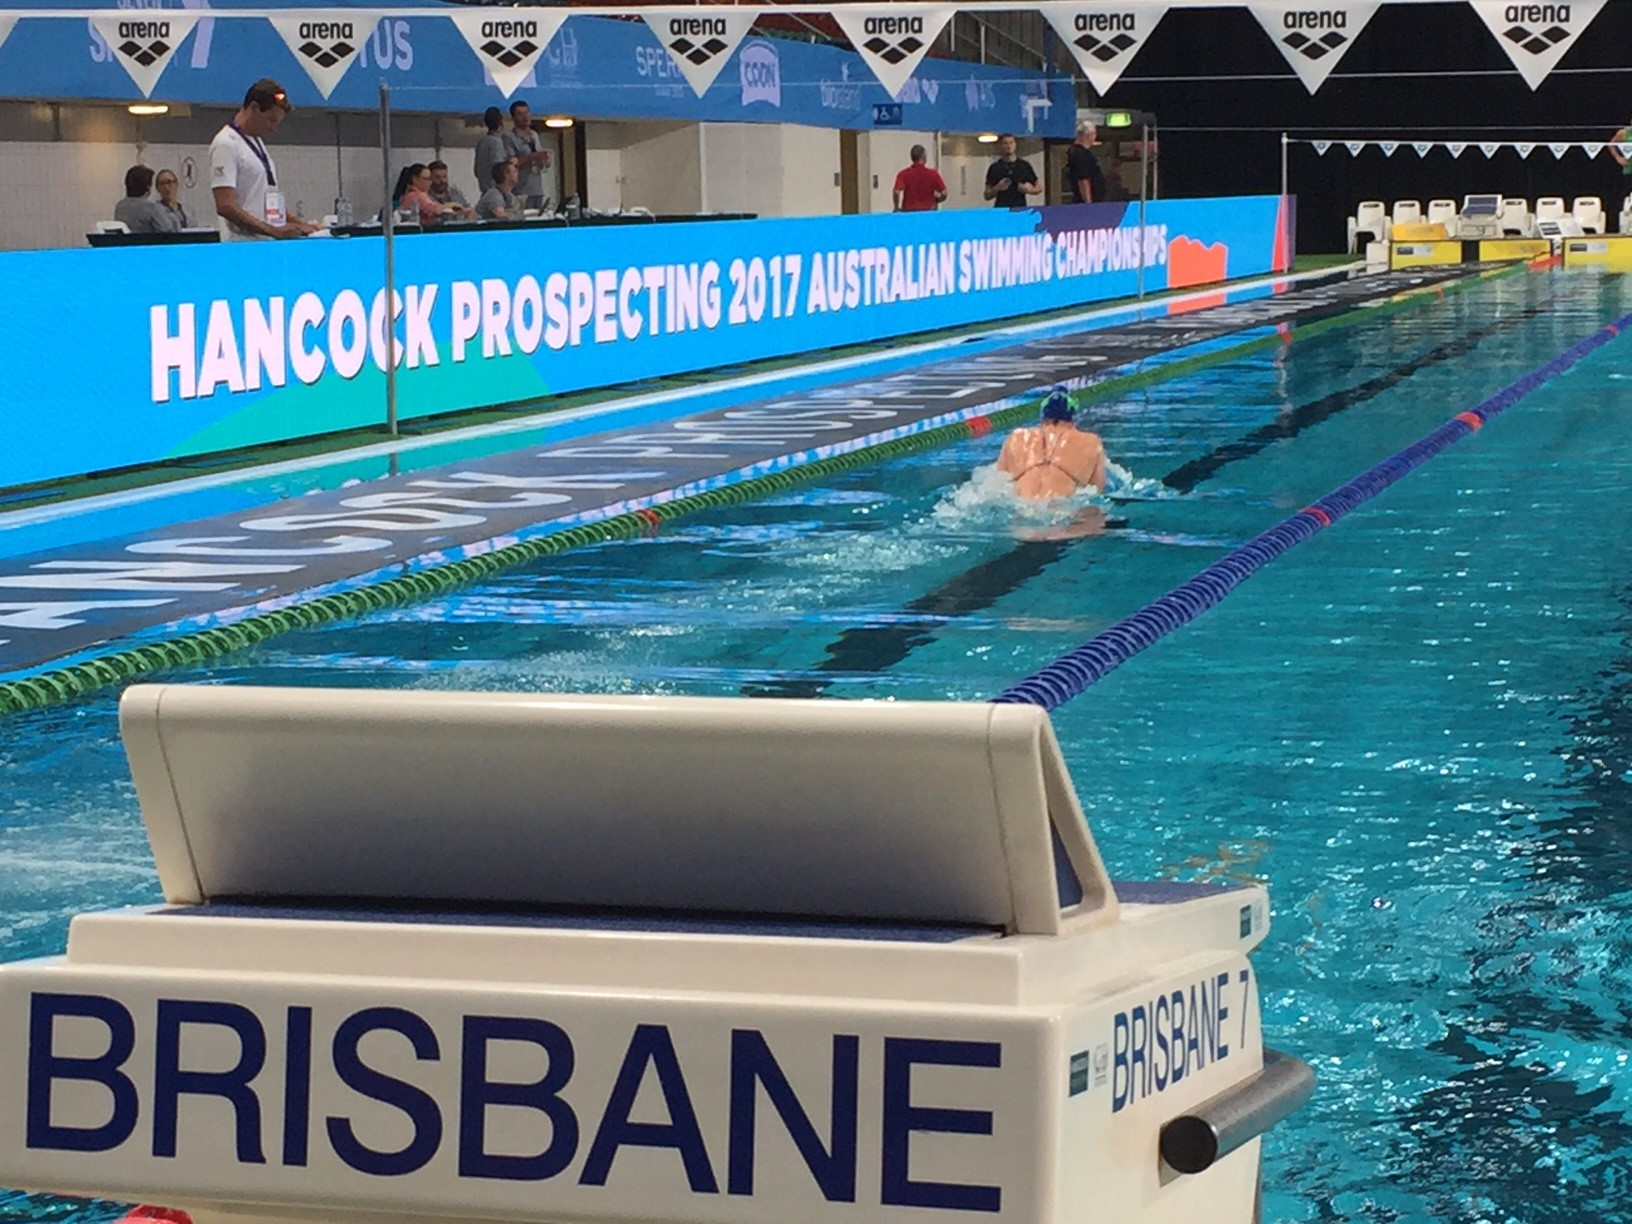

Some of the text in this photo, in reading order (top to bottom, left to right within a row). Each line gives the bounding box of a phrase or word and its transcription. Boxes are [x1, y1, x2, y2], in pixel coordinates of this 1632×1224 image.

[1074, 13, 1135, 32] arena
[1283, 10, 1347, 30] arena
[1505, 4, 1571, 23] arena
[118, 21, 170, 39] arena
[299, 22, 354, 40] arena
[481, 20, 537, 38] arena
[669, 18, 727, 36] arena
[864, 16, 923, 35] arena
[150, 224, 1168, 402] HANCOCK PROSPECTING 2017 AUSTRALIAN SWIMMING CHAMPIONSHIPS
[1112, 971, 1229, 1113] BRISBANE
[1239, 969, 1250, 1050] 7
[26, 992, 1002, 1213] BRISBANE
